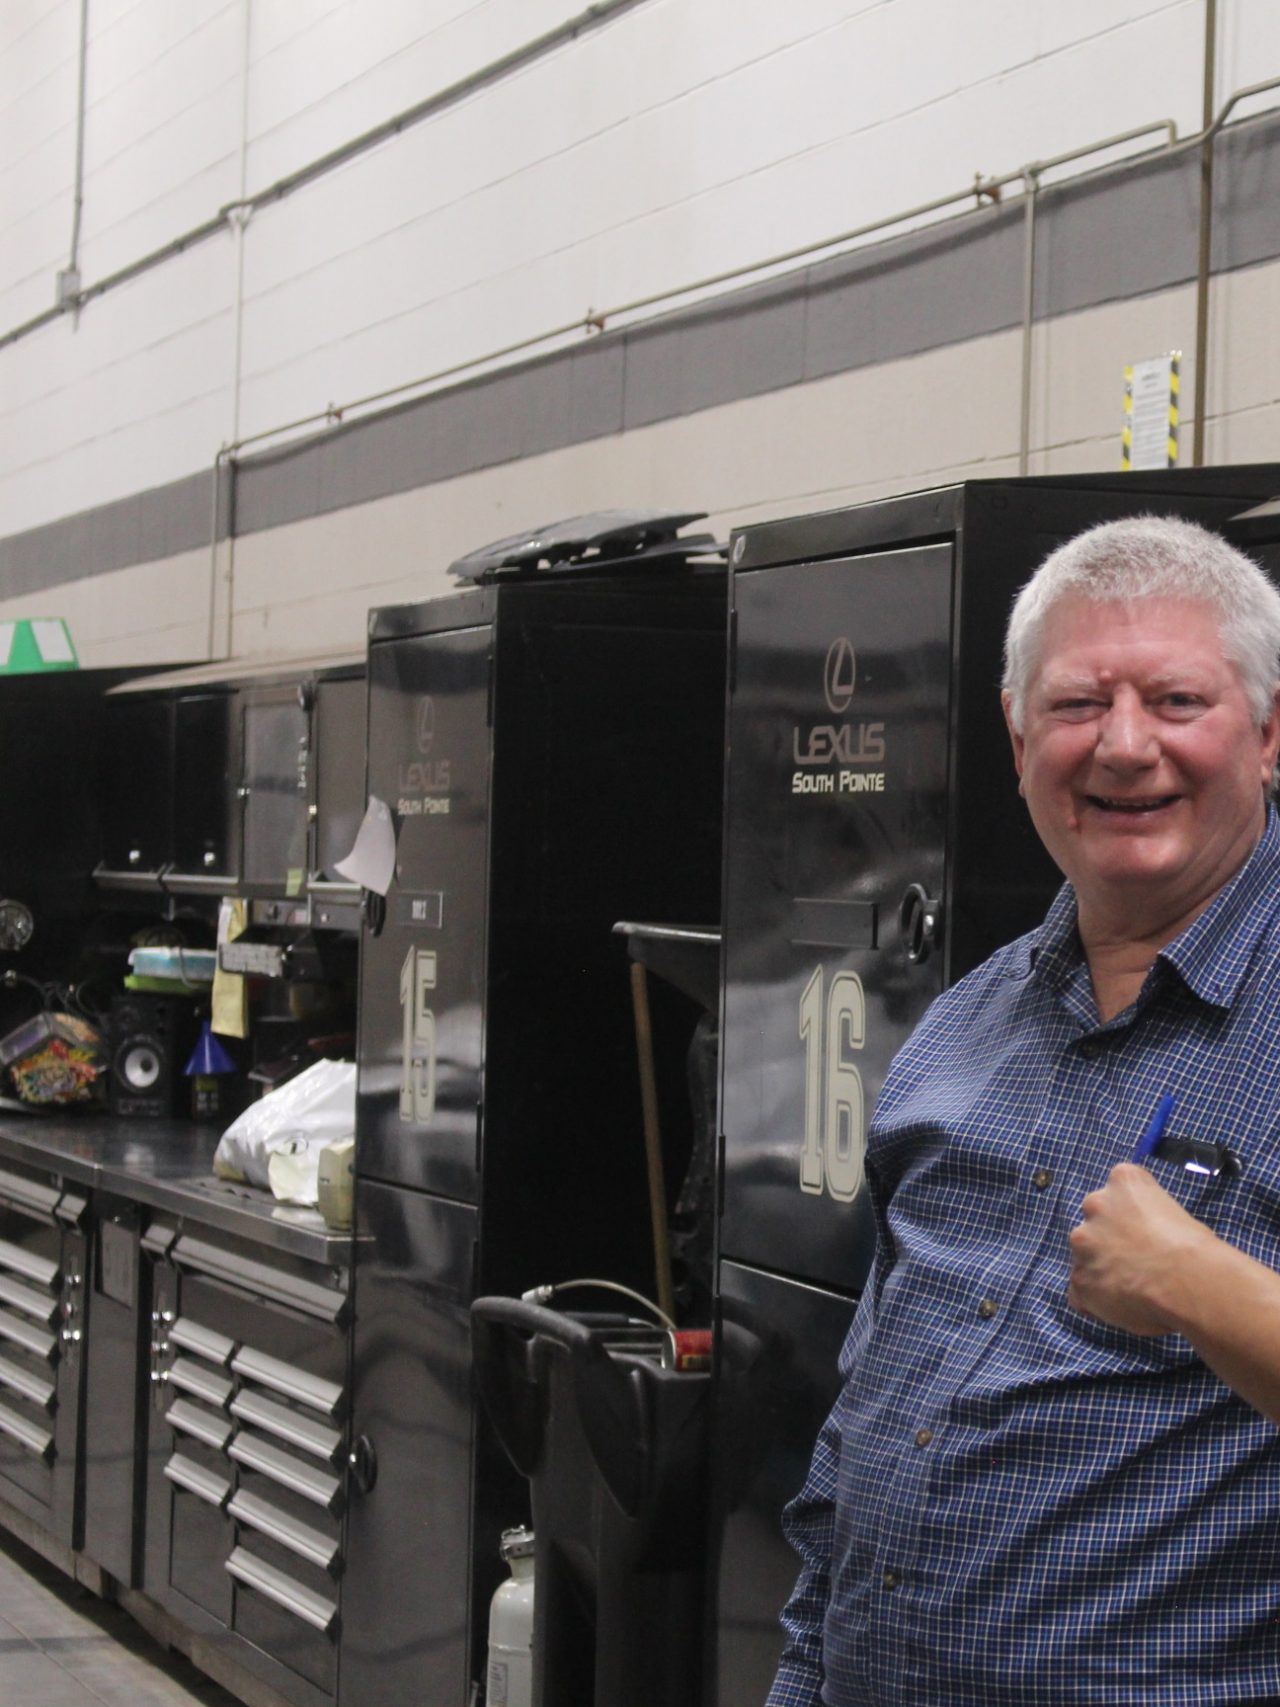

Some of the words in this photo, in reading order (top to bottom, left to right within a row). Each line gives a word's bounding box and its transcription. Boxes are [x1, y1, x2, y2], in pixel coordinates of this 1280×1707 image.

[793, 722, 887, 765] LEXUS
[398, 760, 451, 794] LEXUS
[791, 771, 835, 794] SOUTH
[838, 769, 886, 793] POINTE
[400, 943, 438, 1126] 15
[799, 963, 866, 1203] 16
